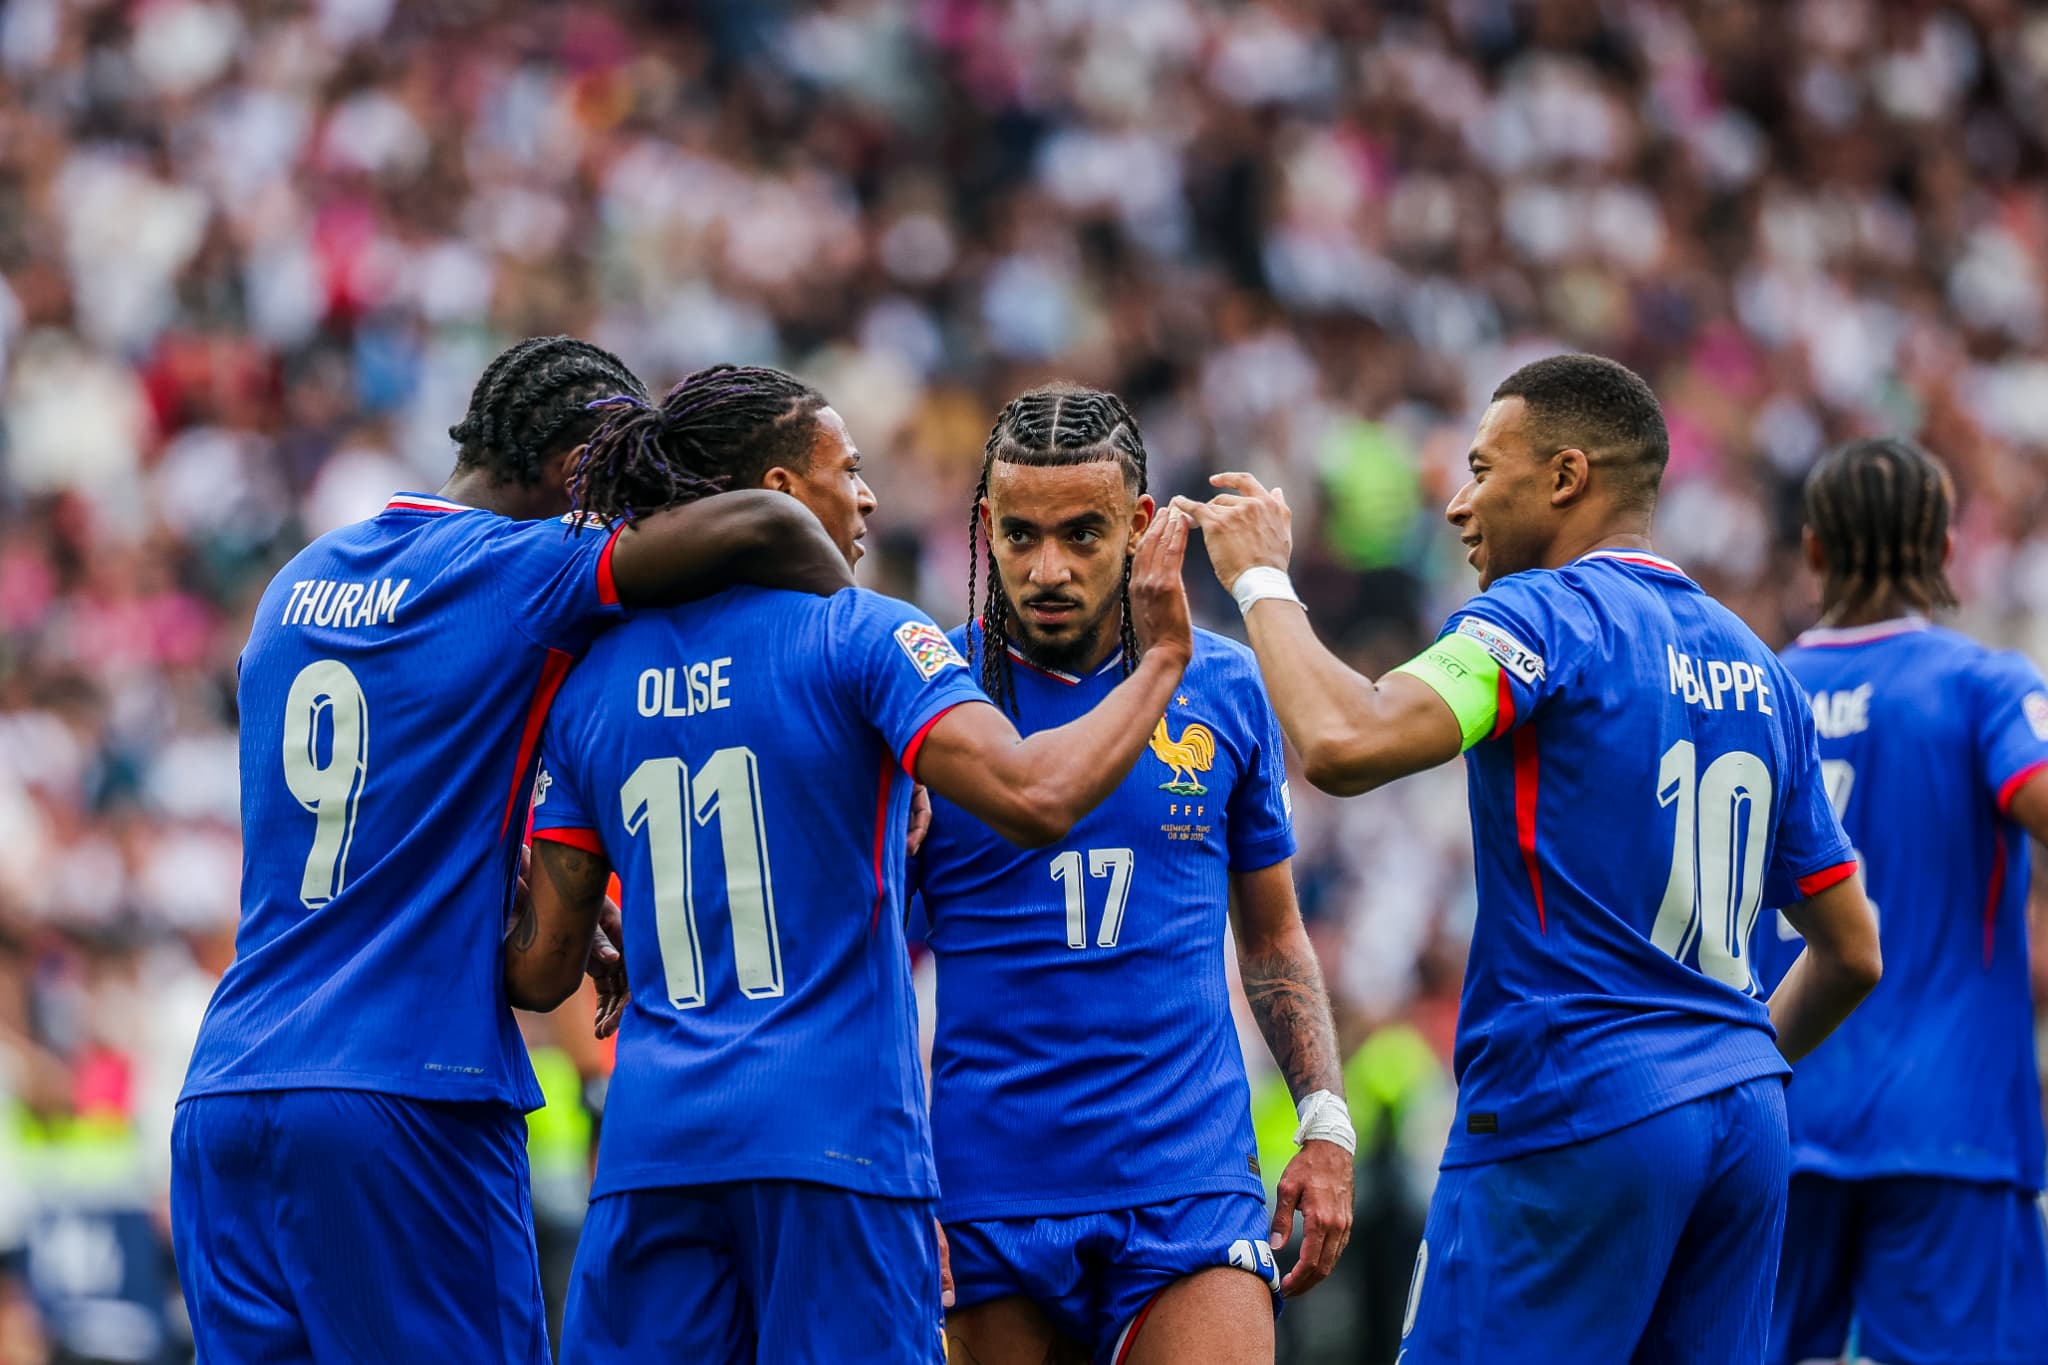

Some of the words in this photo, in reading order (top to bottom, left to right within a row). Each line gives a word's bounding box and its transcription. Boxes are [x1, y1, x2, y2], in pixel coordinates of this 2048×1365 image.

[281, 578, 411, 628] THURAM
[637, 656, 732, 718] OLISE
[1667, 643, 1773, 717] MBAPPE
[1811, 681, 1873, 739] ADÉ
[283, 659, 369, 909] 9
[620, 746, 784, 1010] 11
[1050, 848, 1134, 949] 17
[1650, 739, 1773, 998] 10
